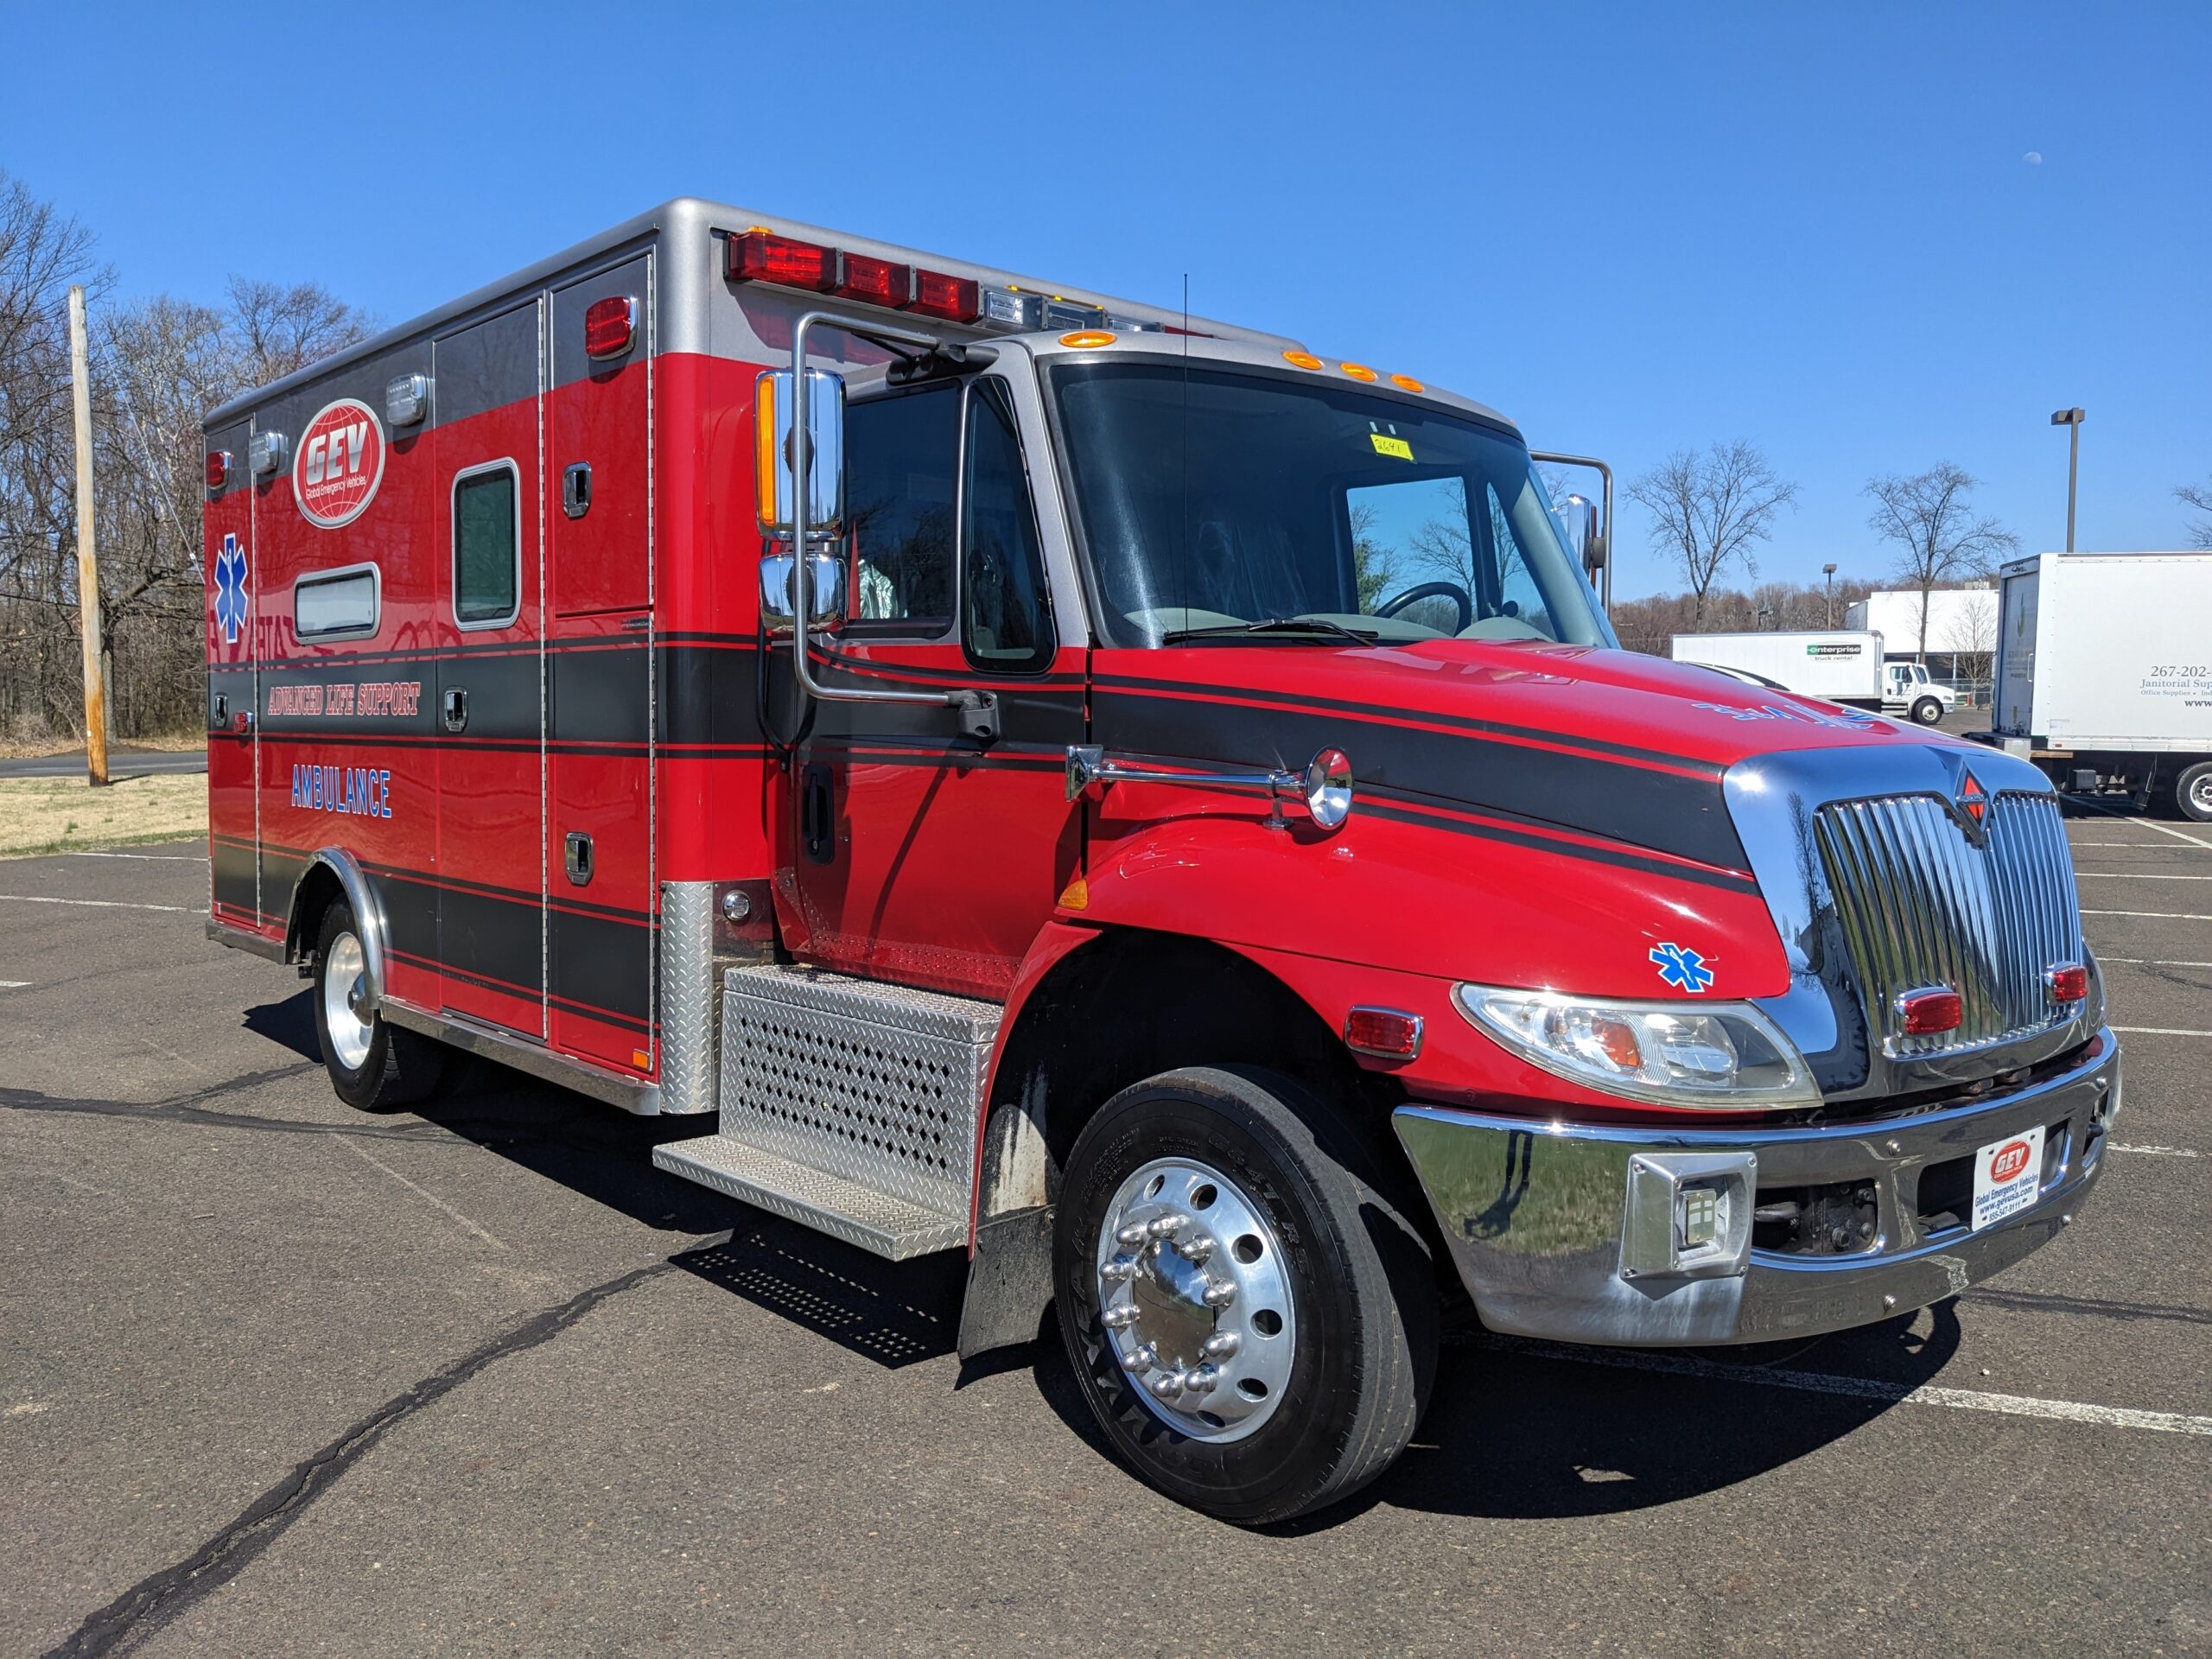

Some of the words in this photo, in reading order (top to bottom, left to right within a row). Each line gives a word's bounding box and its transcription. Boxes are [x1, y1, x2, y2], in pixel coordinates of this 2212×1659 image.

[306, 421, 368, 486] GEV
[1375, 439, 1401, 454] 2641
[305, 485, 321, 499] Global
[321, 480, 346, 495] Emergency
[346, 474, 366, 488] Vehicles
[268, 685, 323, 715] ADVANCED
[326, 683, 354, 715] LIFE
[357, 681, 421, 715] SUPPORT
[2139, 679, 2190, 689] Janitorial
[291, 764, 391, 818] AMBULANCE
[1995, 1147, 2025, 1173] GEV
[1975, 1191, 1991, 1207] Global
[1991, 1181, 2018, 1200] Emergency
[2019, 1173, 2038, 1187] Vehicles
[1980, 1185, 2033, 1215] www.gevusa.com
